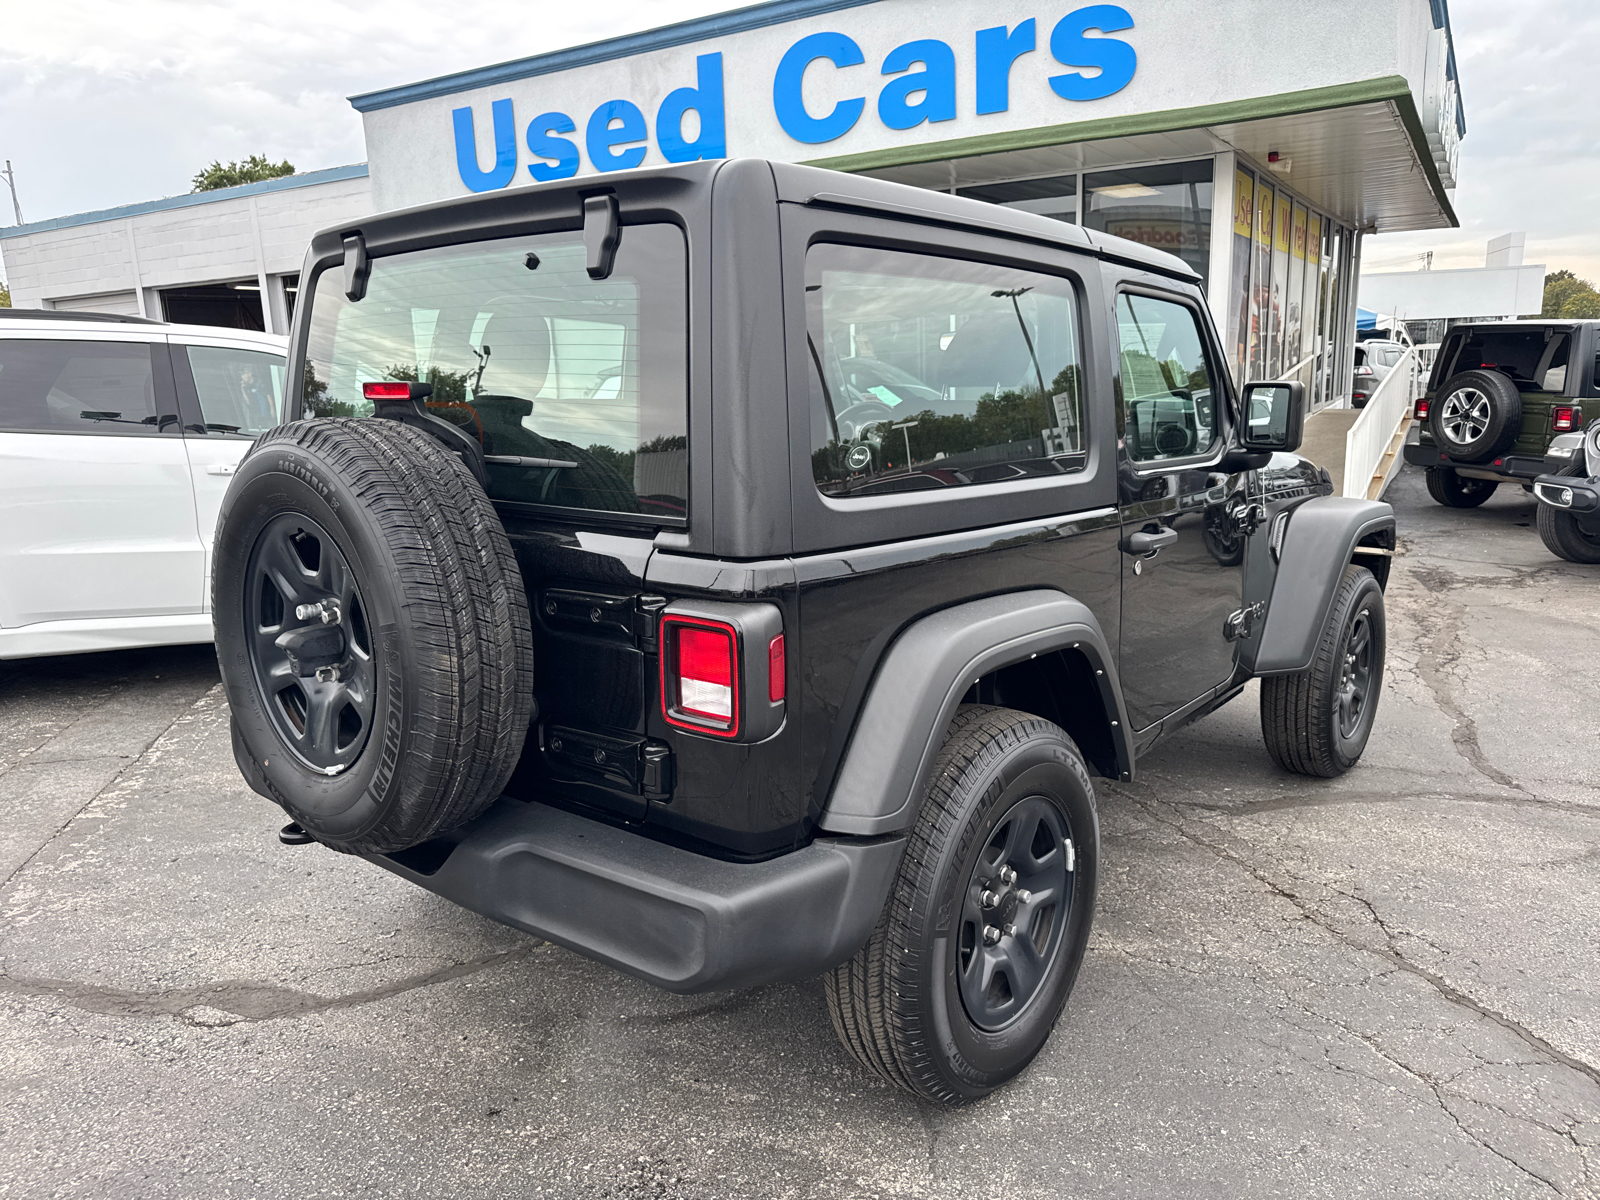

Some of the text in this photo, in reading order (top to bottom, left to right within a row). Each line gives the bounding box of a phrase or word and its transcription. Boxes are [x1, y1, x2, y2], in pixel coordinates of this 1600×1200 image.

[453, 4, 1137, 193] Used Cars
[372, 669, 402, 799] MICHELIN
[1052, 748, 1078, 771] LTX
[945, 776, 1004, 889] MICHELIN
